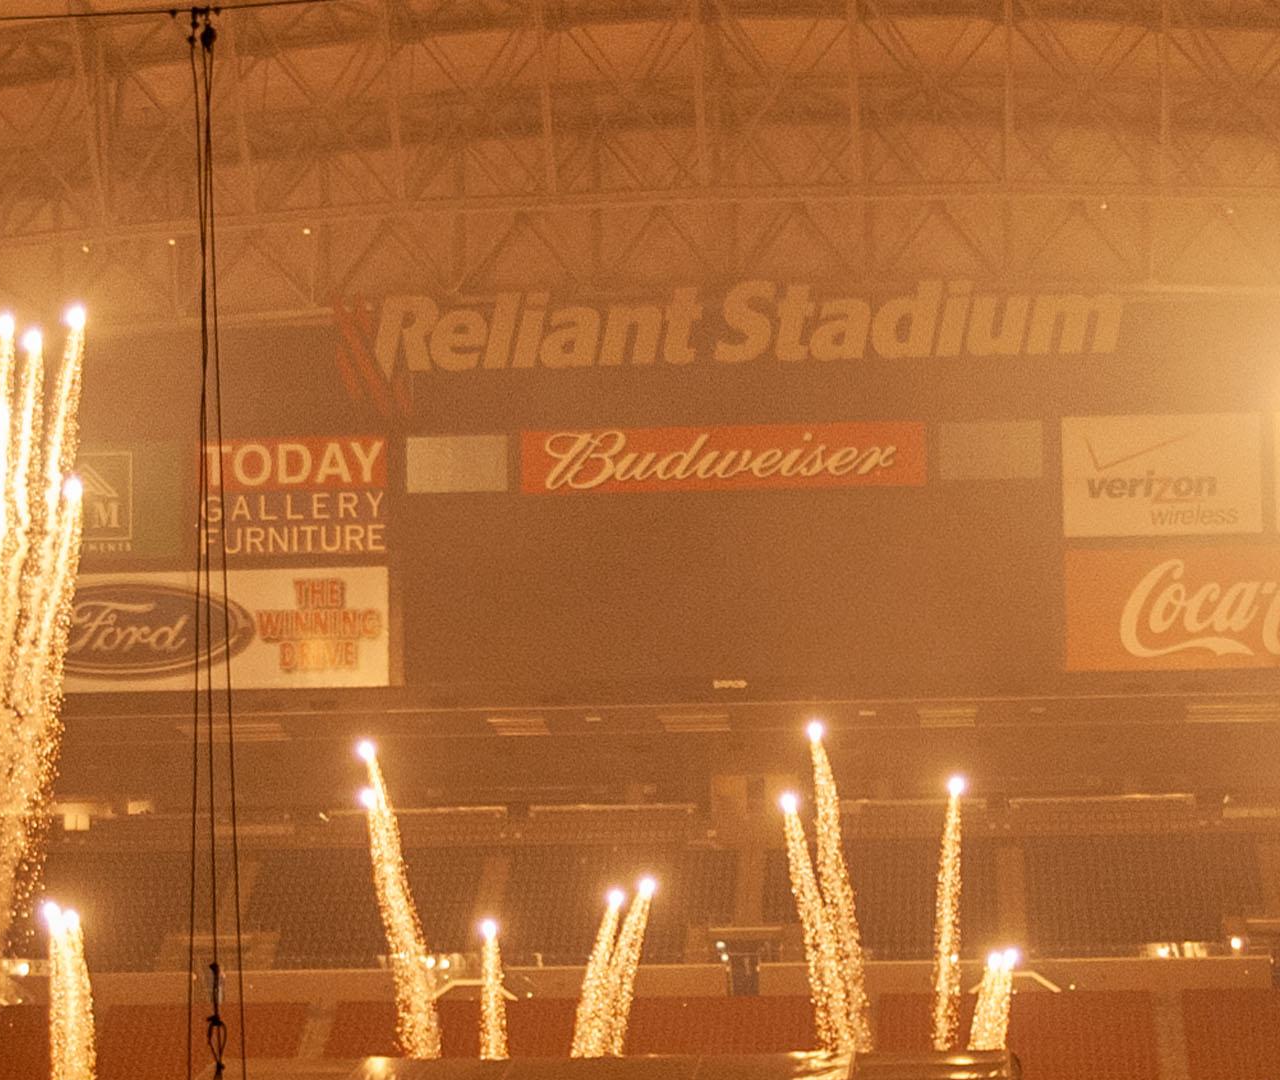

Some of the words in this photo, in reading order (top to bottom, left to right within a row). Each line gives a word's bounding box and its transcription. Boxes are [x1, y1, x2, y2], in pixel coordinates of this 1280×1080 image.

[375, 286, 704, 381] Reliant
[714, 279, 1122, 362] Stadium
[201, 441, 384, 487] TODAY
[545, 430, 897, 490] Budweiser
[1087, 470, 1217, 504] verizon
[201, 491, 385, 523] GALLERY
[1151, 505, 1239, 526] wireless
[200, 524, 387, 554] FURNITURE
[293, 578, 347, 609] THE
[70, 600, 190, 651] Ford
[256, 609, 381, 641] WINNING
[278, 641, 358, 671] DRIVE
